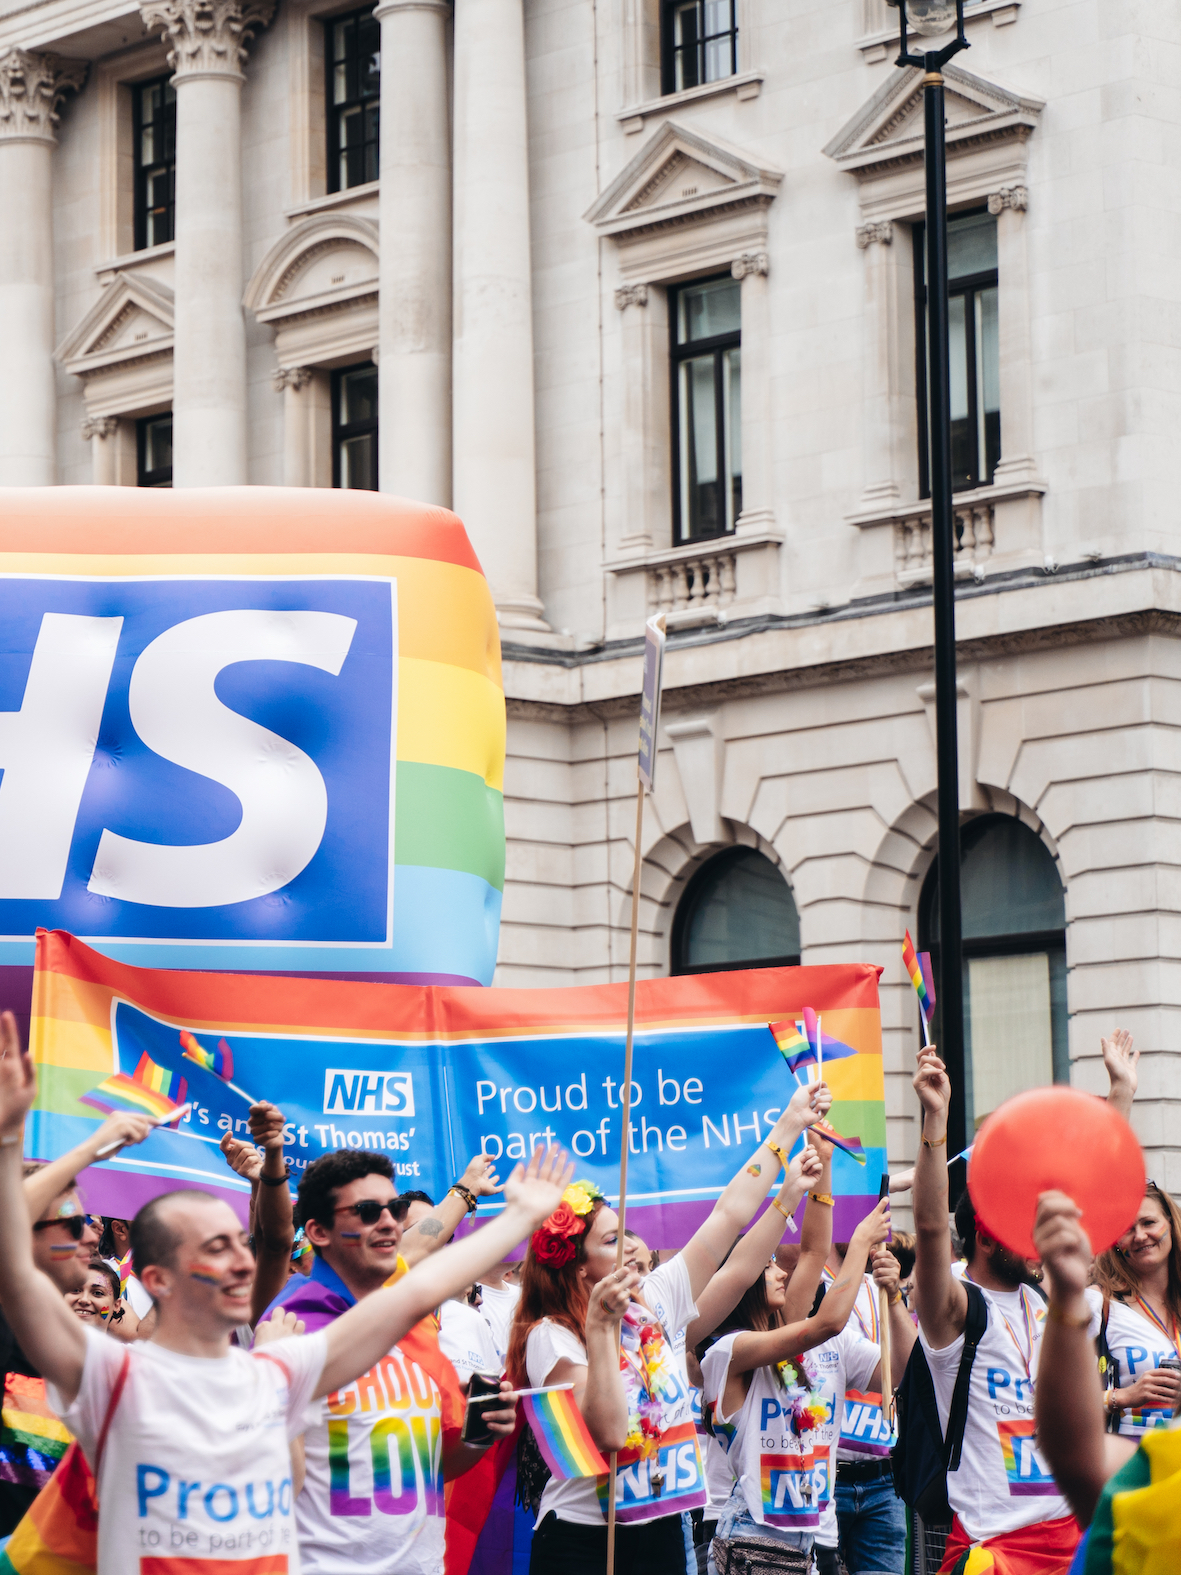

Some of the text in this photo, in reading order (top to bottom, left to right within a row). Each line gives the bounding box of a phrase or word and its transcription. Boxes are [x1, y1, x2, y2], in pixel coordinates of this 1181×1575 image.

[326, 1074, 407, 1112] NHS
[476, 1068, 705, 1115] Proud to be
[217, 1113, 251, 1134] an
[282, 1123, 309, 1147] St
[480, 1125, 558, 1160] part
[571, 1118, 611, 1157] of
[628, 1116, 688, 1153] the
[327, 1355, 441, 1415] CHOO
[993, 1402, 1034, 1416] to be
[760, 1436, 775, 1448] to
[781, 1435, 794, 1448] be
[821, 1428, 834, 1440] the
[615, 1443, 698, 1503] NHS
[138, 1526, 161, 1547] to
[170, 1523, 199, 1548] be
[209, 1527, 254, 1553] part
[258, 1522, 274, 1547] of
